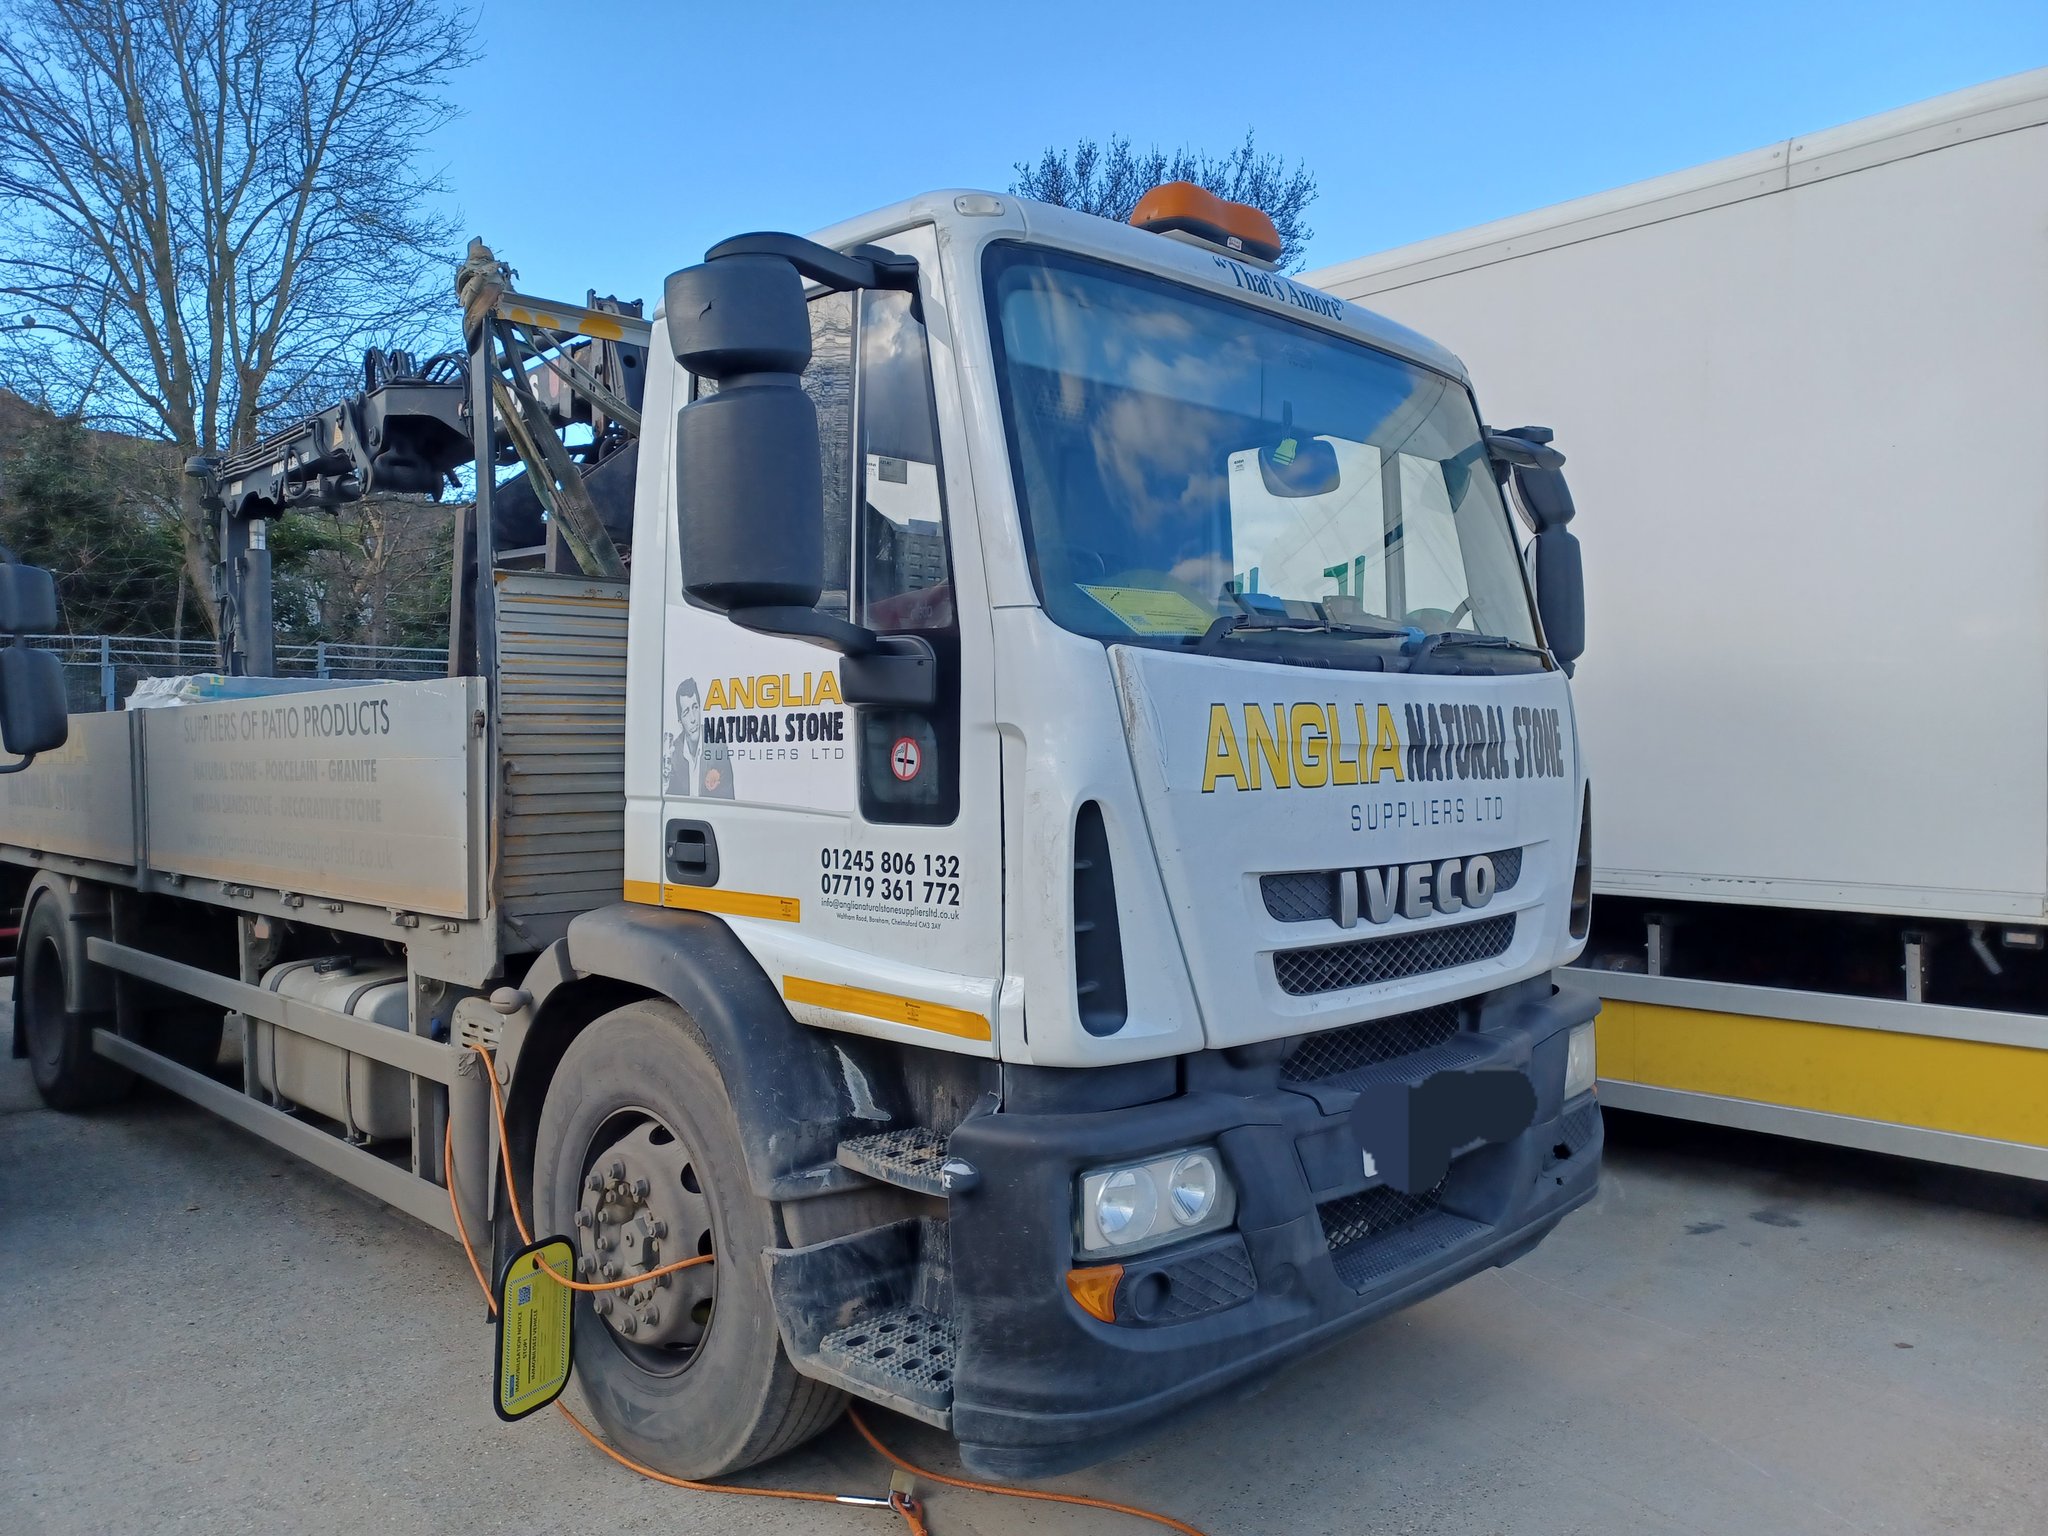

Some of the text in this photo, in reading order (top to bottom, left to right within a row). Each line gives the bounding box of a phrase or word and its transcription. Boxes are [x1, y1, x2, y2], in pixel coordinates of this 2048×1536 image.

[703, 670, 843, 711] ANGLIA
[184, 698, 391, 744] SUPPLIERS OF PATIO PRODUCTS
[703, 711, 843, 745] NATURAL STONE
[704, 748, 844, 761] SUPPLIERS LTD
[1201, 702, 1565, 793] ANGLIA NATURAL STONE
[193, 760, 228, 782] NATURAL
[230, 760, 257, 781] STONE
[265, 759, 318, 782] PORCELAIN
[328, 758, 377, 783] GRANITE
[281, 796, 341, 821] DECORATIVE
[344, 799, 383, 823] STONE
[1351, 796, 1503, 832] SUPPLIERS LTD
[820, 848, 960, 879] 01245 806 132
[820, 874, 960, 907] 07719 361 772
[1339, 855, 1496, 929] IVECO
[821, 898, 960, 920] info@anglianaturalstonesuppliersltd.co.uk
[891, 918, 918, 928] Chelmsford
